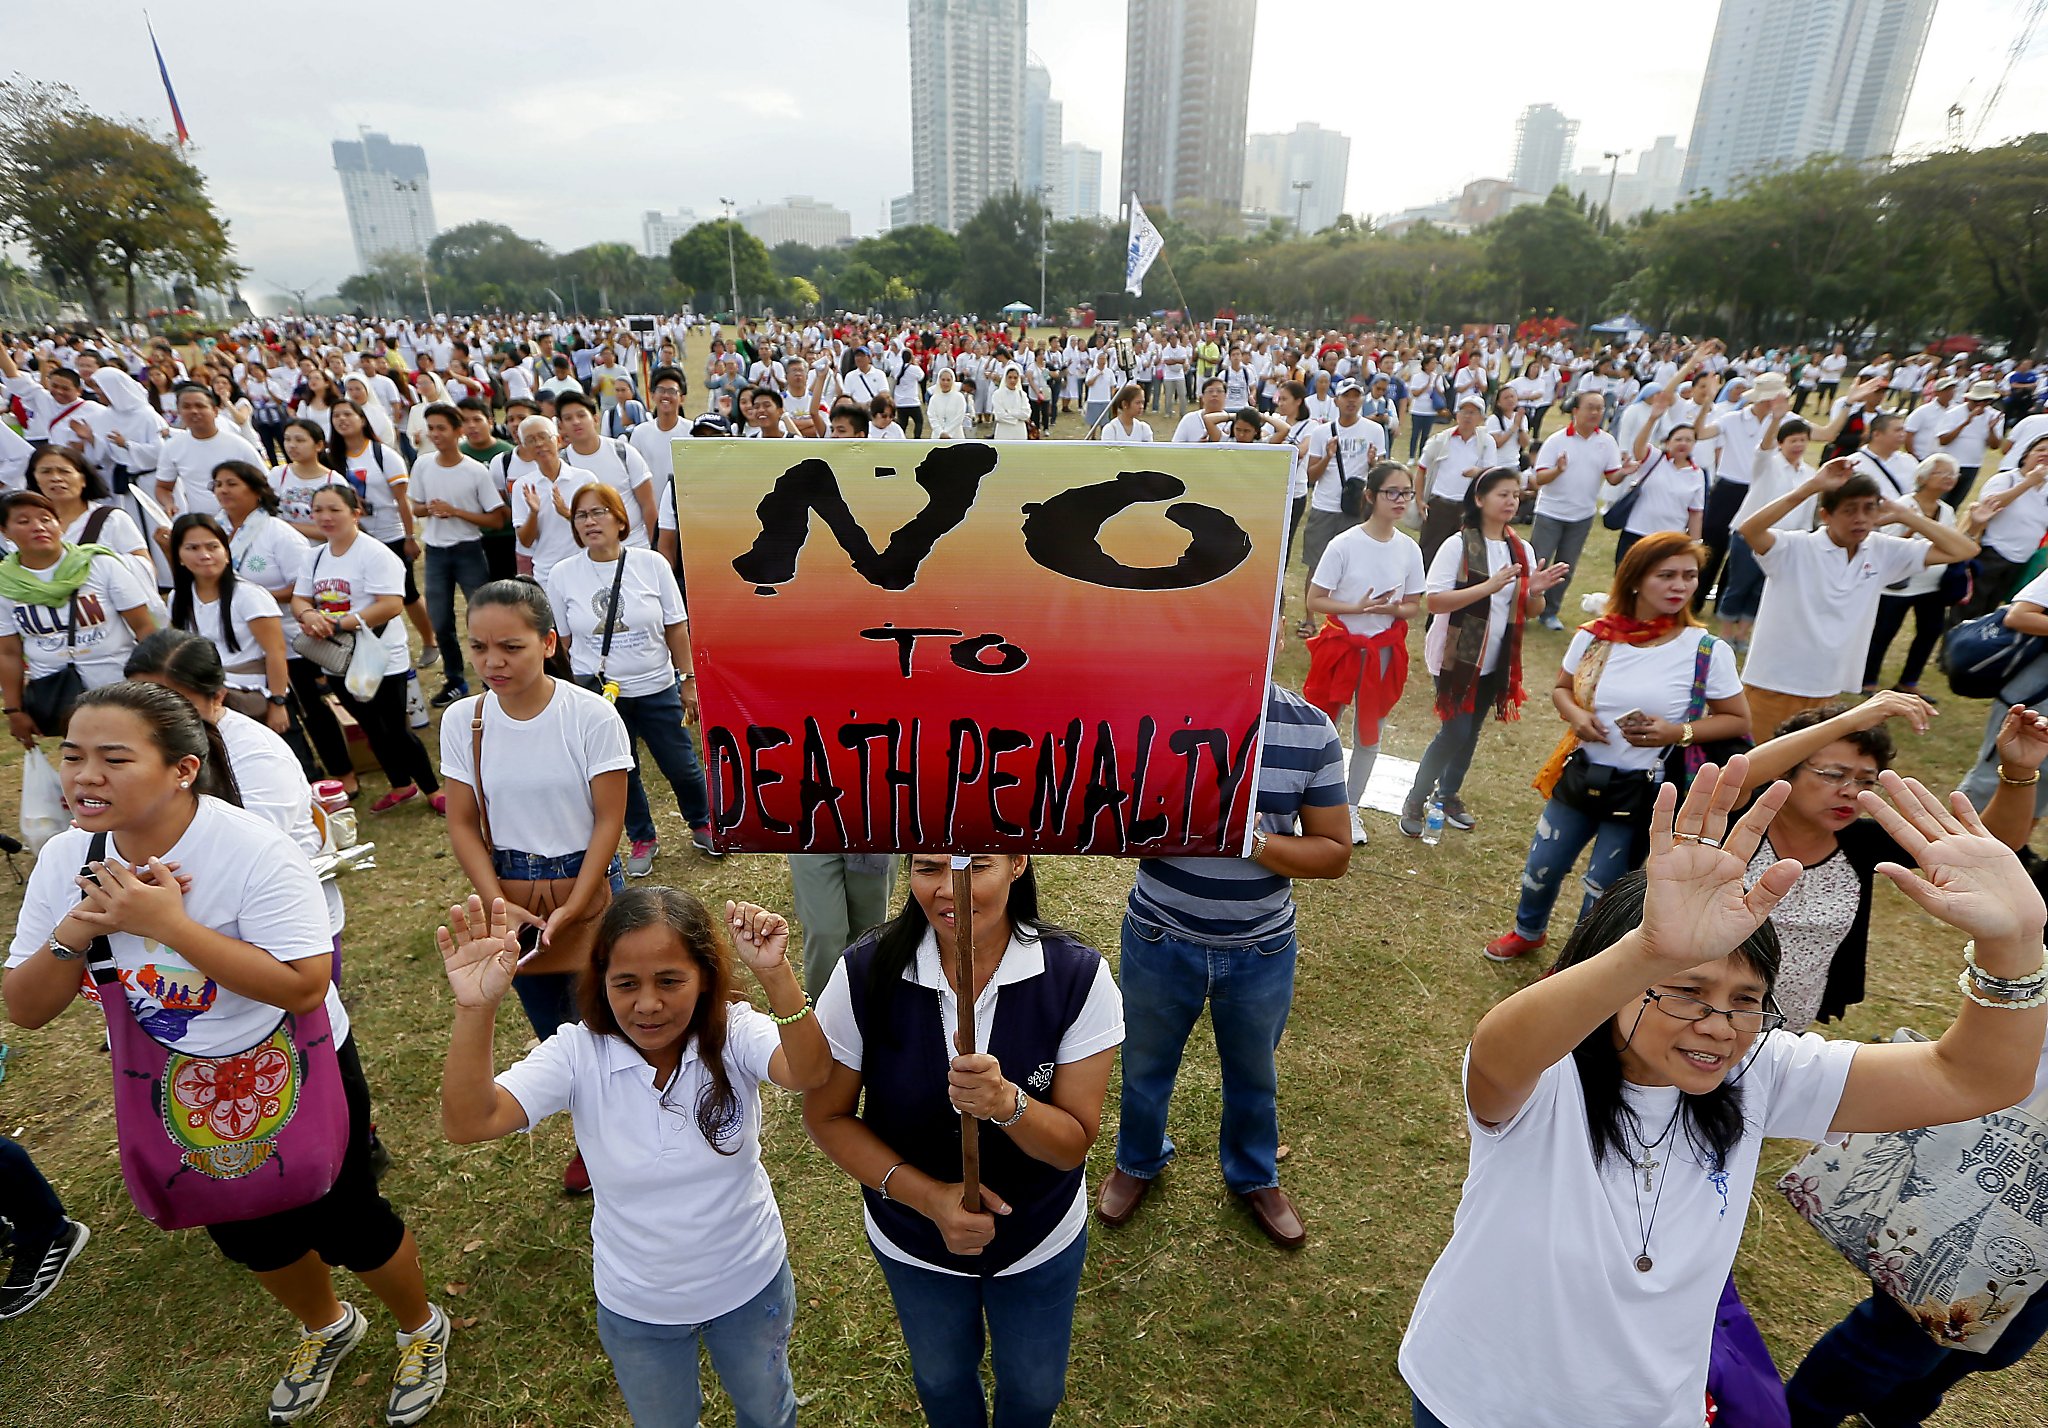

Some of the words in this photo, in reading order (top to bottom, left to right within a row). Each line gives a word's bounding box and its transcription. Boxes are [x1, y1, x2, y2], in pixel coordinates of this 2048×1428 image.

[731, 442, 1254, 592] NO
[859, 623, 1029, 678] TO
[707, 713, 924, 850] DEATH
[943, 714, 1261, 852] PENALTY
[1957, 1149, 2048, 1227] YORK
[1972, 1133, 2048, 1201] NEW
